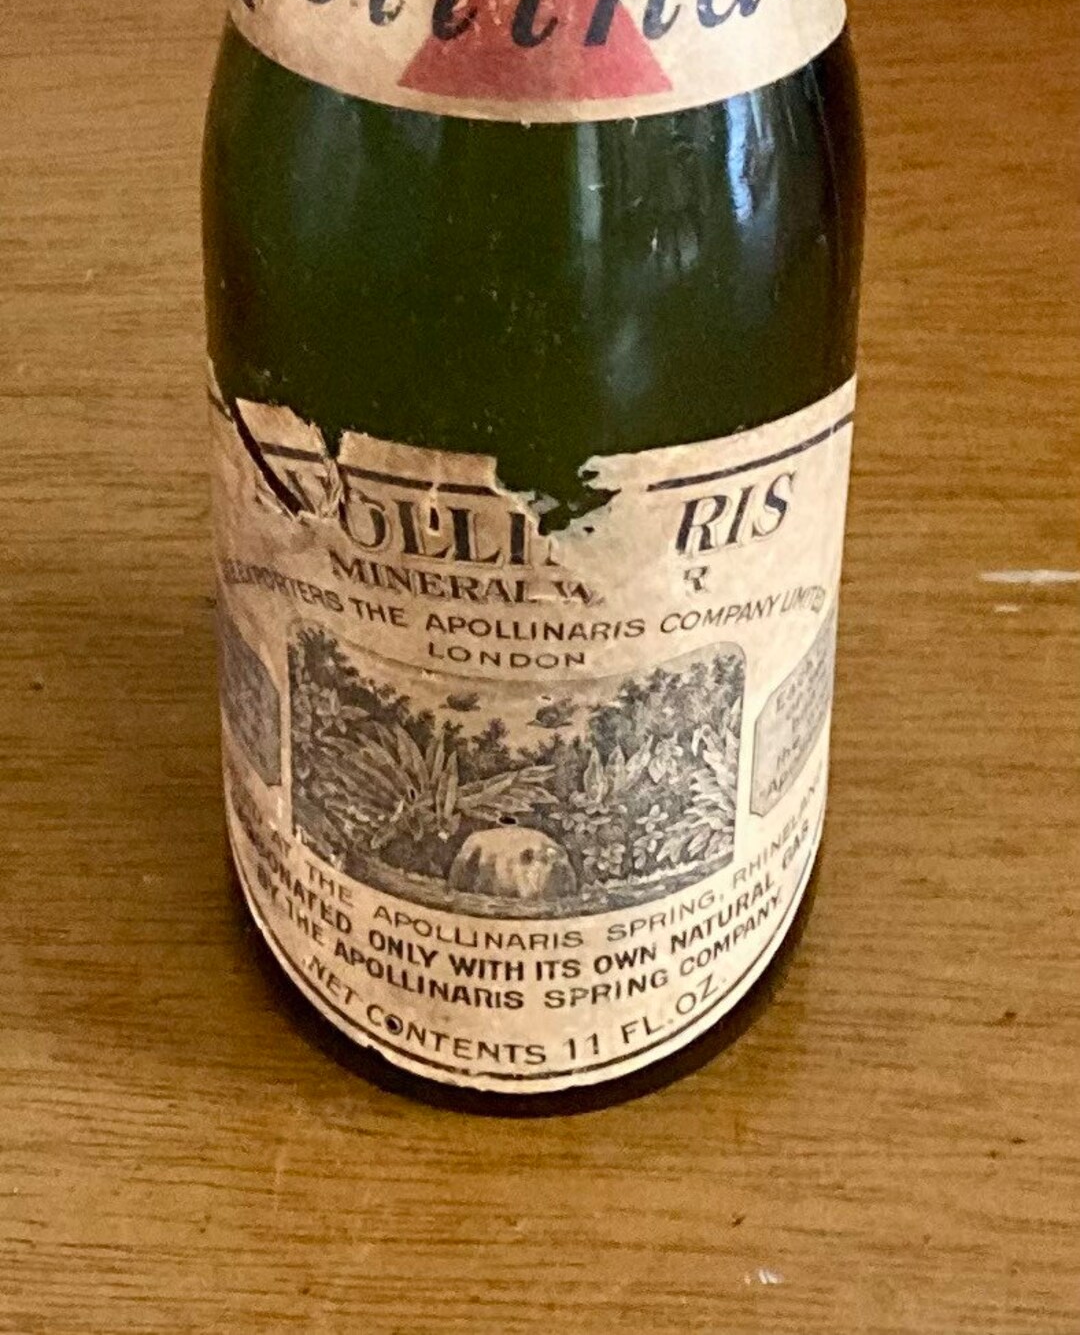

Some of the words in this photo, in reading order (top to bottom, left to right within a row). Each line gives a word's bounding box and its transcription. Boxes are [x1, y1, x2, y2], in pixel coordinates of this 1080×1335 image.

[328, 549, 541, 605] MINERAL
[349, 596, 409, 629] THE
[424, 612, 646, 643] APOLLINARIS
[659, 595, 780, 635] COMPANY
[427, 641, 587, 670] LONDON
[305, 861, 355, 909] THE
[372, 904, 585, 952] APOLLINARIS
[606, 888, 725, 944] SPRING,
[368, 928, 439, 970] ONLY
[447, 952, 525, 982] WITH
[535, 959, 582, 982] ITS
[593, 944, 658, 975] OWN
[669, 872, 776, 955] NATURAL
[285, 896, 325, 947] THE
[333, 937, 525, 1011] APOLLINARIS
[543, 968, 669, 1010] SPRING
[366, 1002, 548, 1066] CONTENTS
